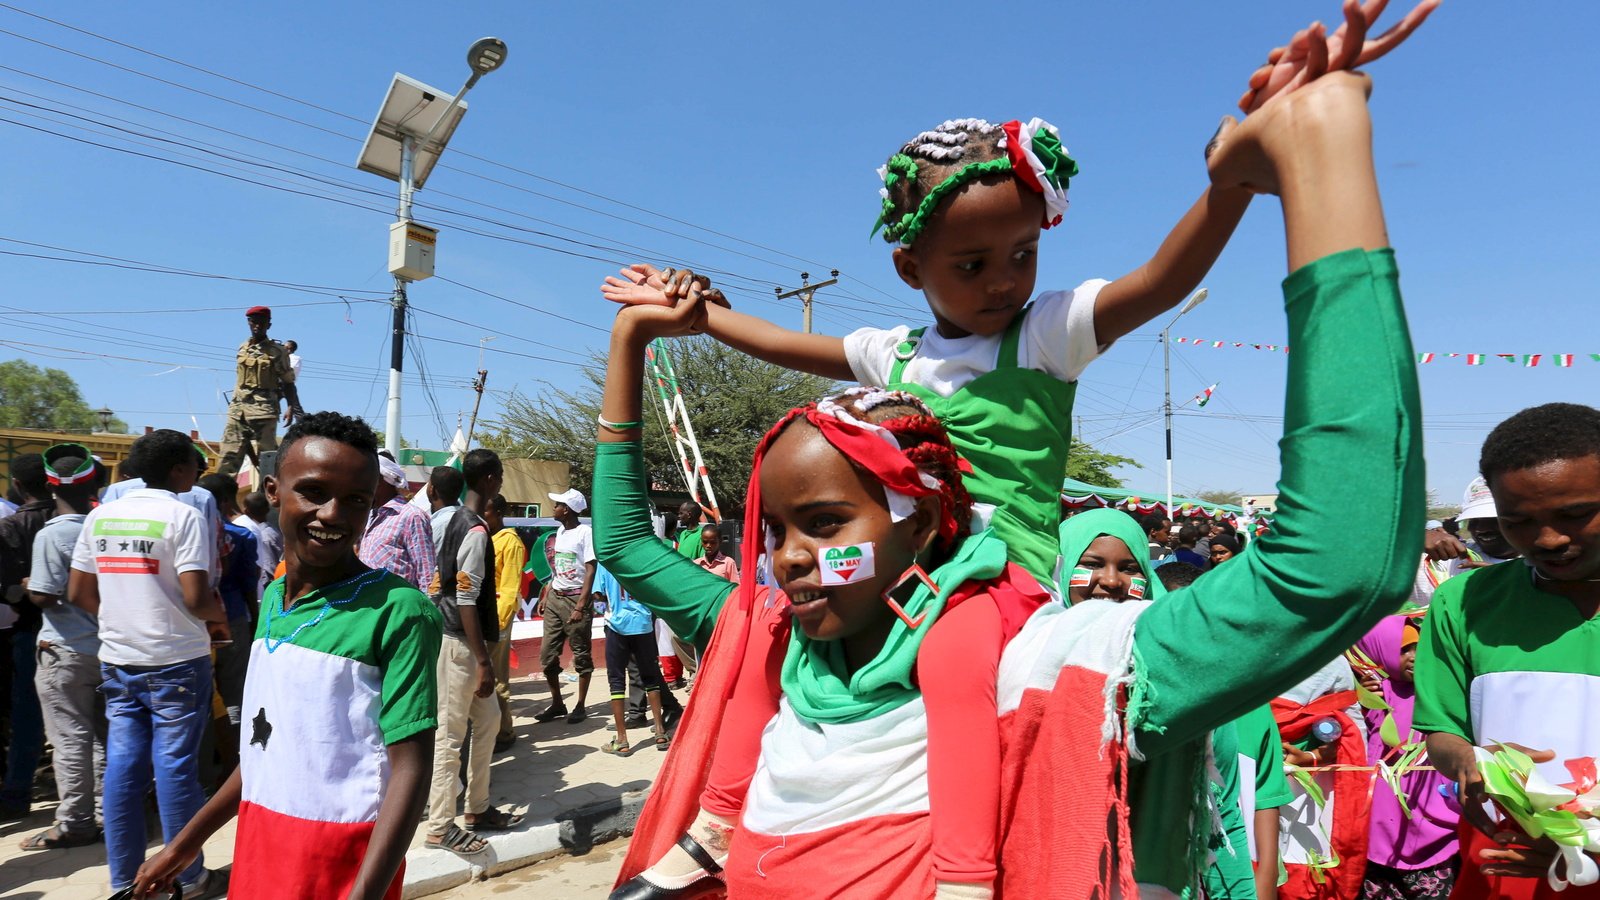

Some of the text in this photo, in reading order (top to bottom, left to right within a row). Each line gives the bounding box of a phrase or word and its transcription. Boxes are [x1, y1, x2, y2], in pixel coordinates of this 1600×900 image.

[96, 539, 154, 554] 18 MAY
[829, 558, 861, 569] 18 MAY
